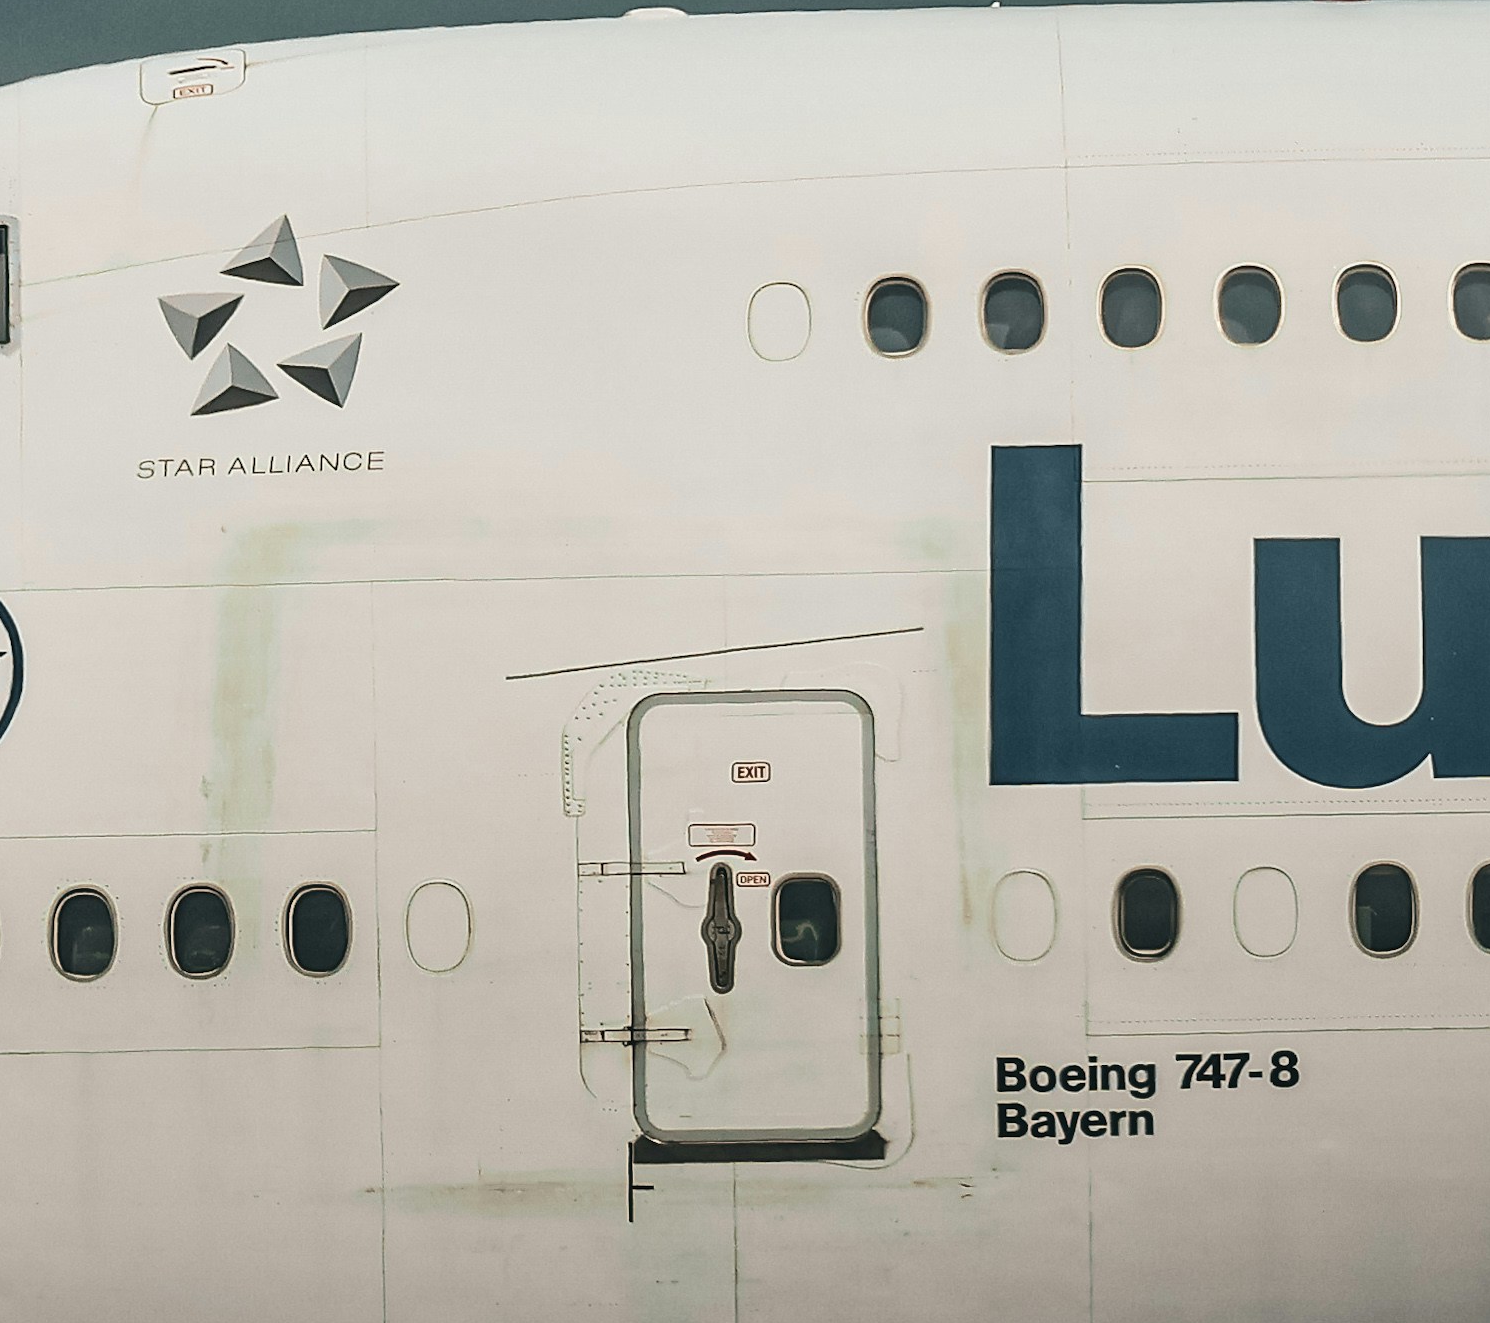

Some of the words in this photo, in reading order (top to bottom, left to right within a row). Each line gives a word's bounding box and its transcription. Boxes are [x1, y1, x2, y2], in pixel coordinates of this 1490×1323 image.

[137, 458, 217, 479] STAR
[228, 451, 385, 475] ALLIANCE
[736, 765, 767, 779] EXIT
[739, 875, 767, 885] OPEN
[995, 1055, 1157, 1099] Boeing
[1175, 1050, 1300, 1090] 747-8
[997, 1102, 1155, 1145] Bayern
